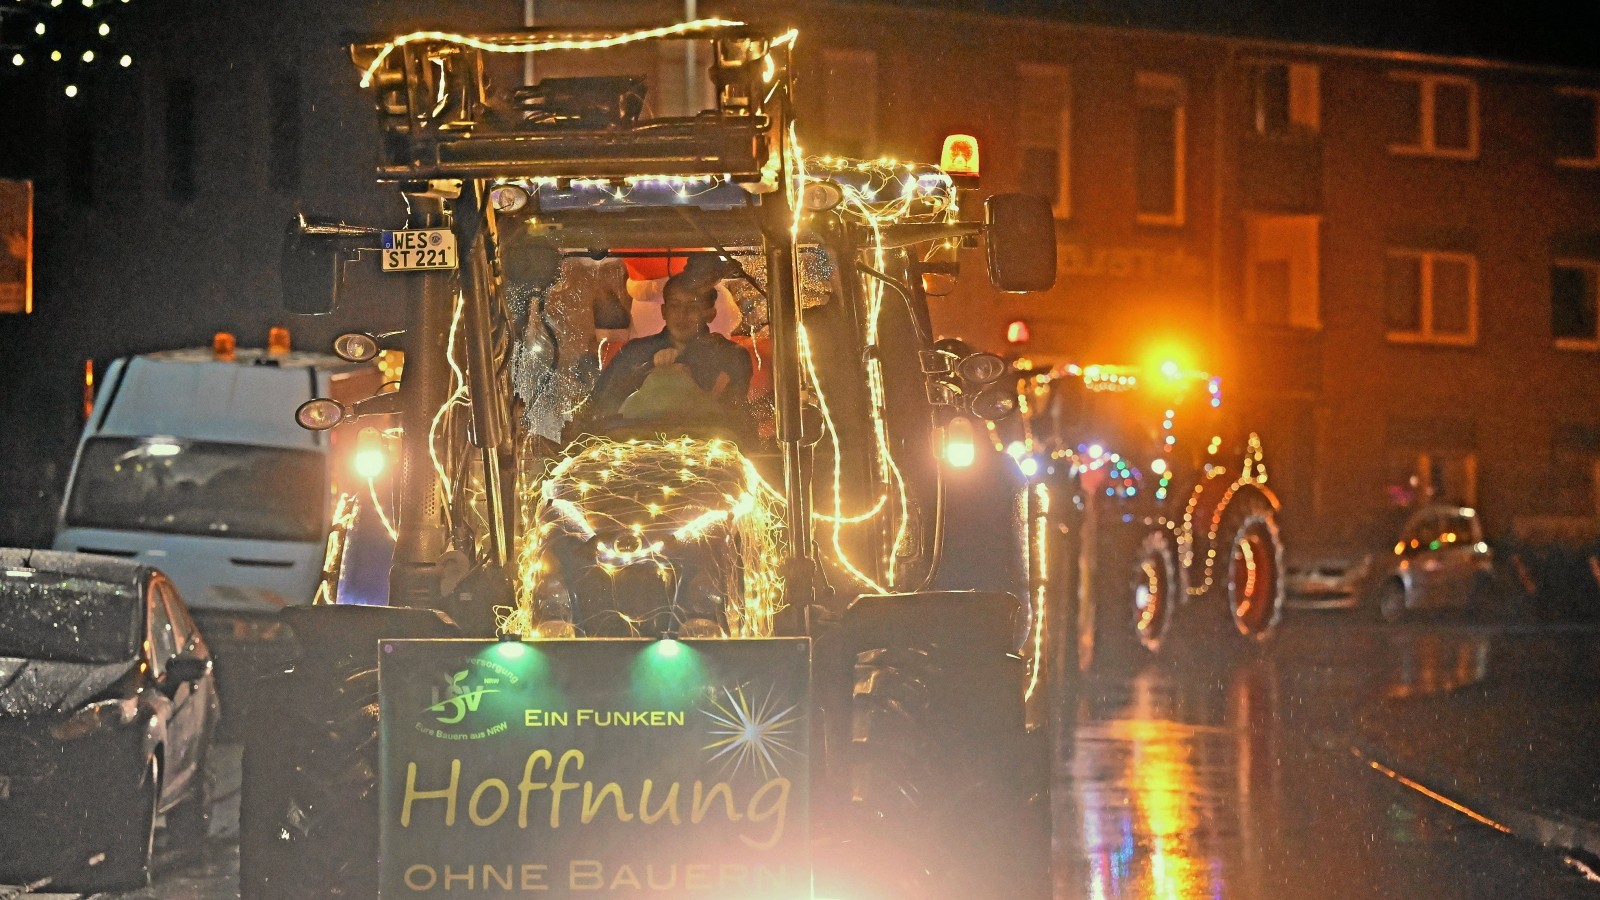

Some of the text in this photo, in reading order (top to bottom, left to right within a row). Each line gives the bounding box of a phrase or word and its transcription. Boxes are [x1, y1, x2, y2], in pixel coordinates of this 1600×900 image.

[394, 232, 428, 249] WES
[389, 249, 448, 268] ST 221
[484, 677, 500, 685] NRW
[415, 721, 508, 740] Eure Bauern aus NRW
[400, 748, 792, 851] Hoffnung
[403, 863, 549, 891] OHNE
